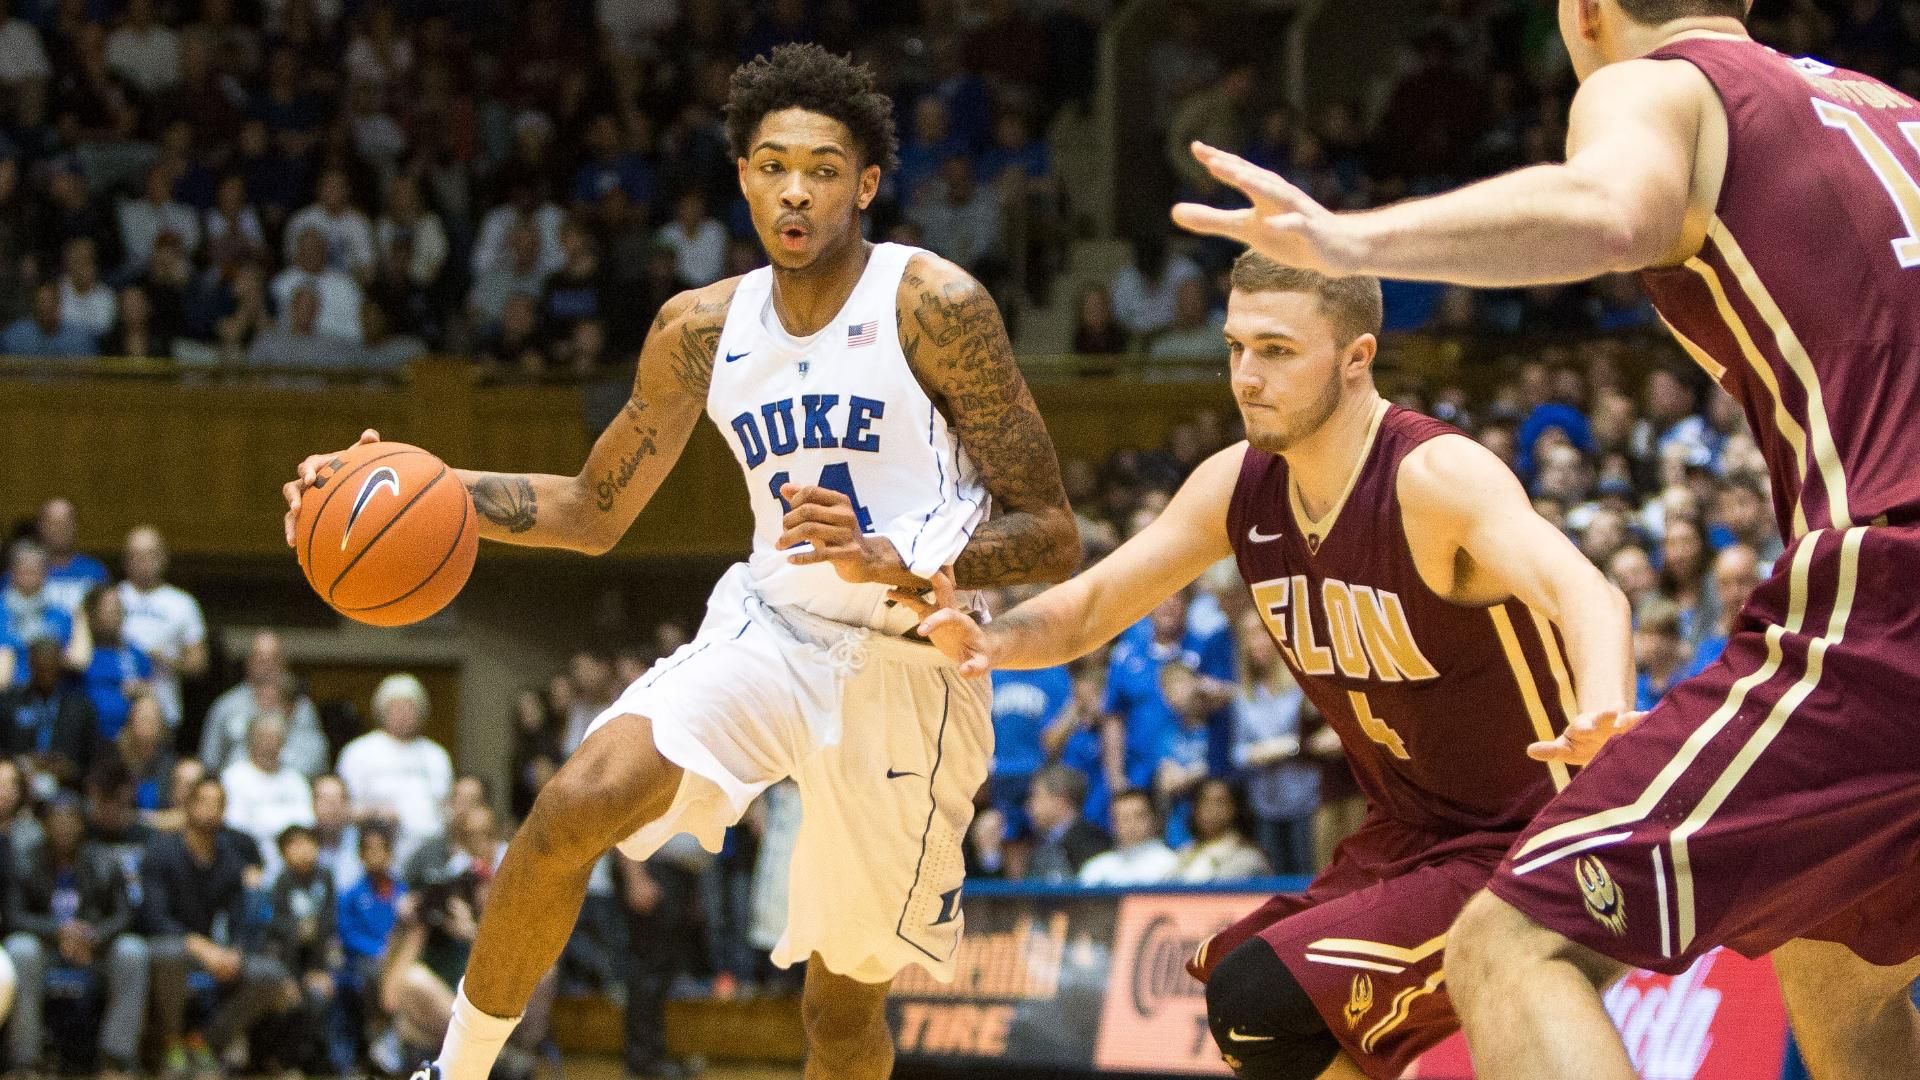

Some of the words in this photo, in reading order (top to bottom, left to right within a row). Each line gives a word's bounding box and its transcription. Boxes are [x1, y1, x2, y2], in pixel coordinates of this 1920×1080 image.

[731, 394, 885, 470] DUKE
[1251, 575, 1440, 682] ELON
[1348, 690, 1411, 759] 4
